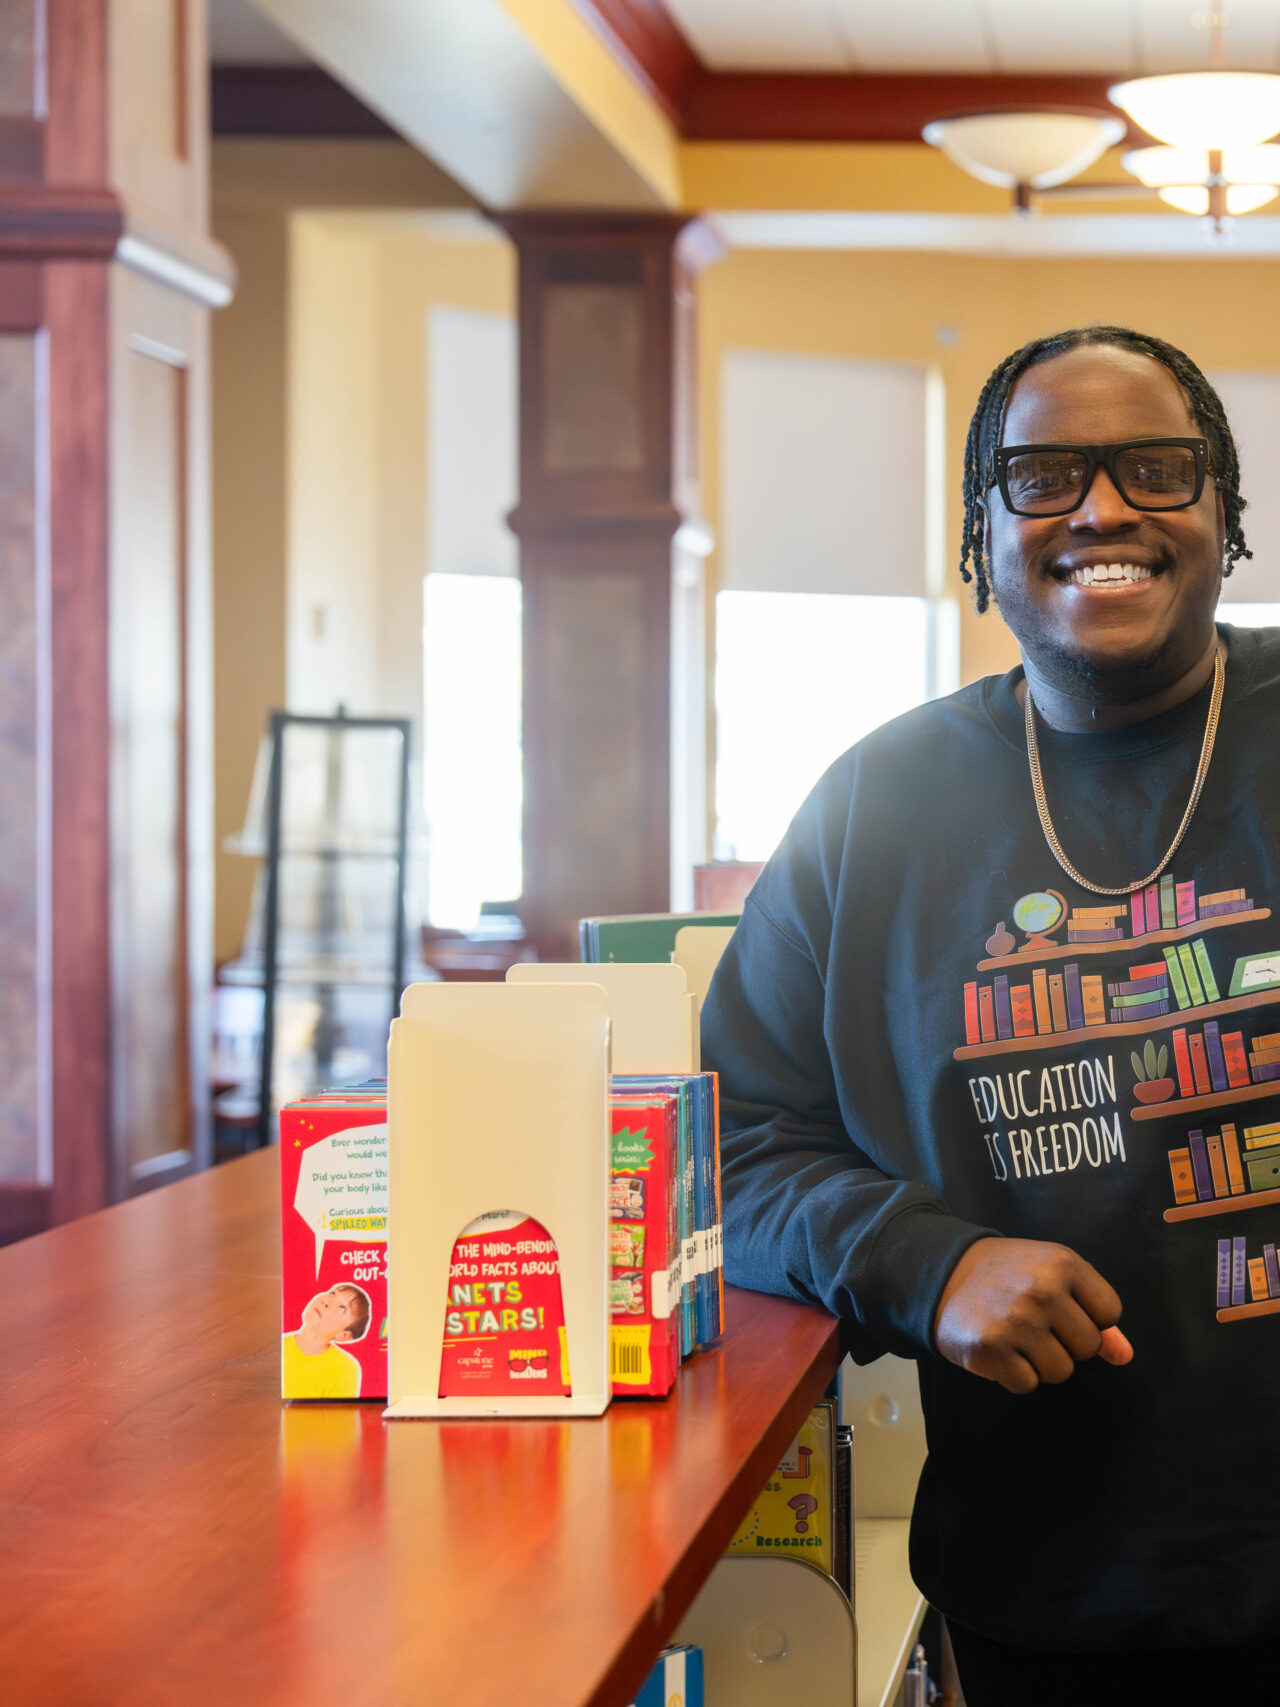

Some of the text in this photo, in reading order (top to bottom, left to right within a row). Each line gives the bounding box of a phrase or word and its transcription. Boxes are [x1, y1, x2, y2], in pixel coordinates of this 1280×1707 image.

[968, 1055, 1117, 1123] EDUCATION
[331, 1136, 386, 1148] Ever wonder
[983, 1112, 1126, 1182] IS FREEDOM
[346, 1150, 373, 1159] would
[312, 1172, 327, 1181] Did
[330, 1173, 347, 1183] you
[349, 1169, 373, 1179] know
[323, 1185, 344, 1196] your
[347, 1184, 370, 1194] body
[329, 1208, 364, 1217] Curious
[330, 1217, 387, 1231] SPILLED WAT
[340, 1250, 380, 1265] CHECK
[457, 1243, 480, 1258] THE
[481, 1261, 518, 1276] FACTS
[521, 1260, 560, 1275] ABOUT
[447, 1281, 523, 1306] NETS
[446, 1307, 544, 1335] STARS!
[509, 1350, 547, 1360] MIND
[756, 1535, 822, 1547] Research
